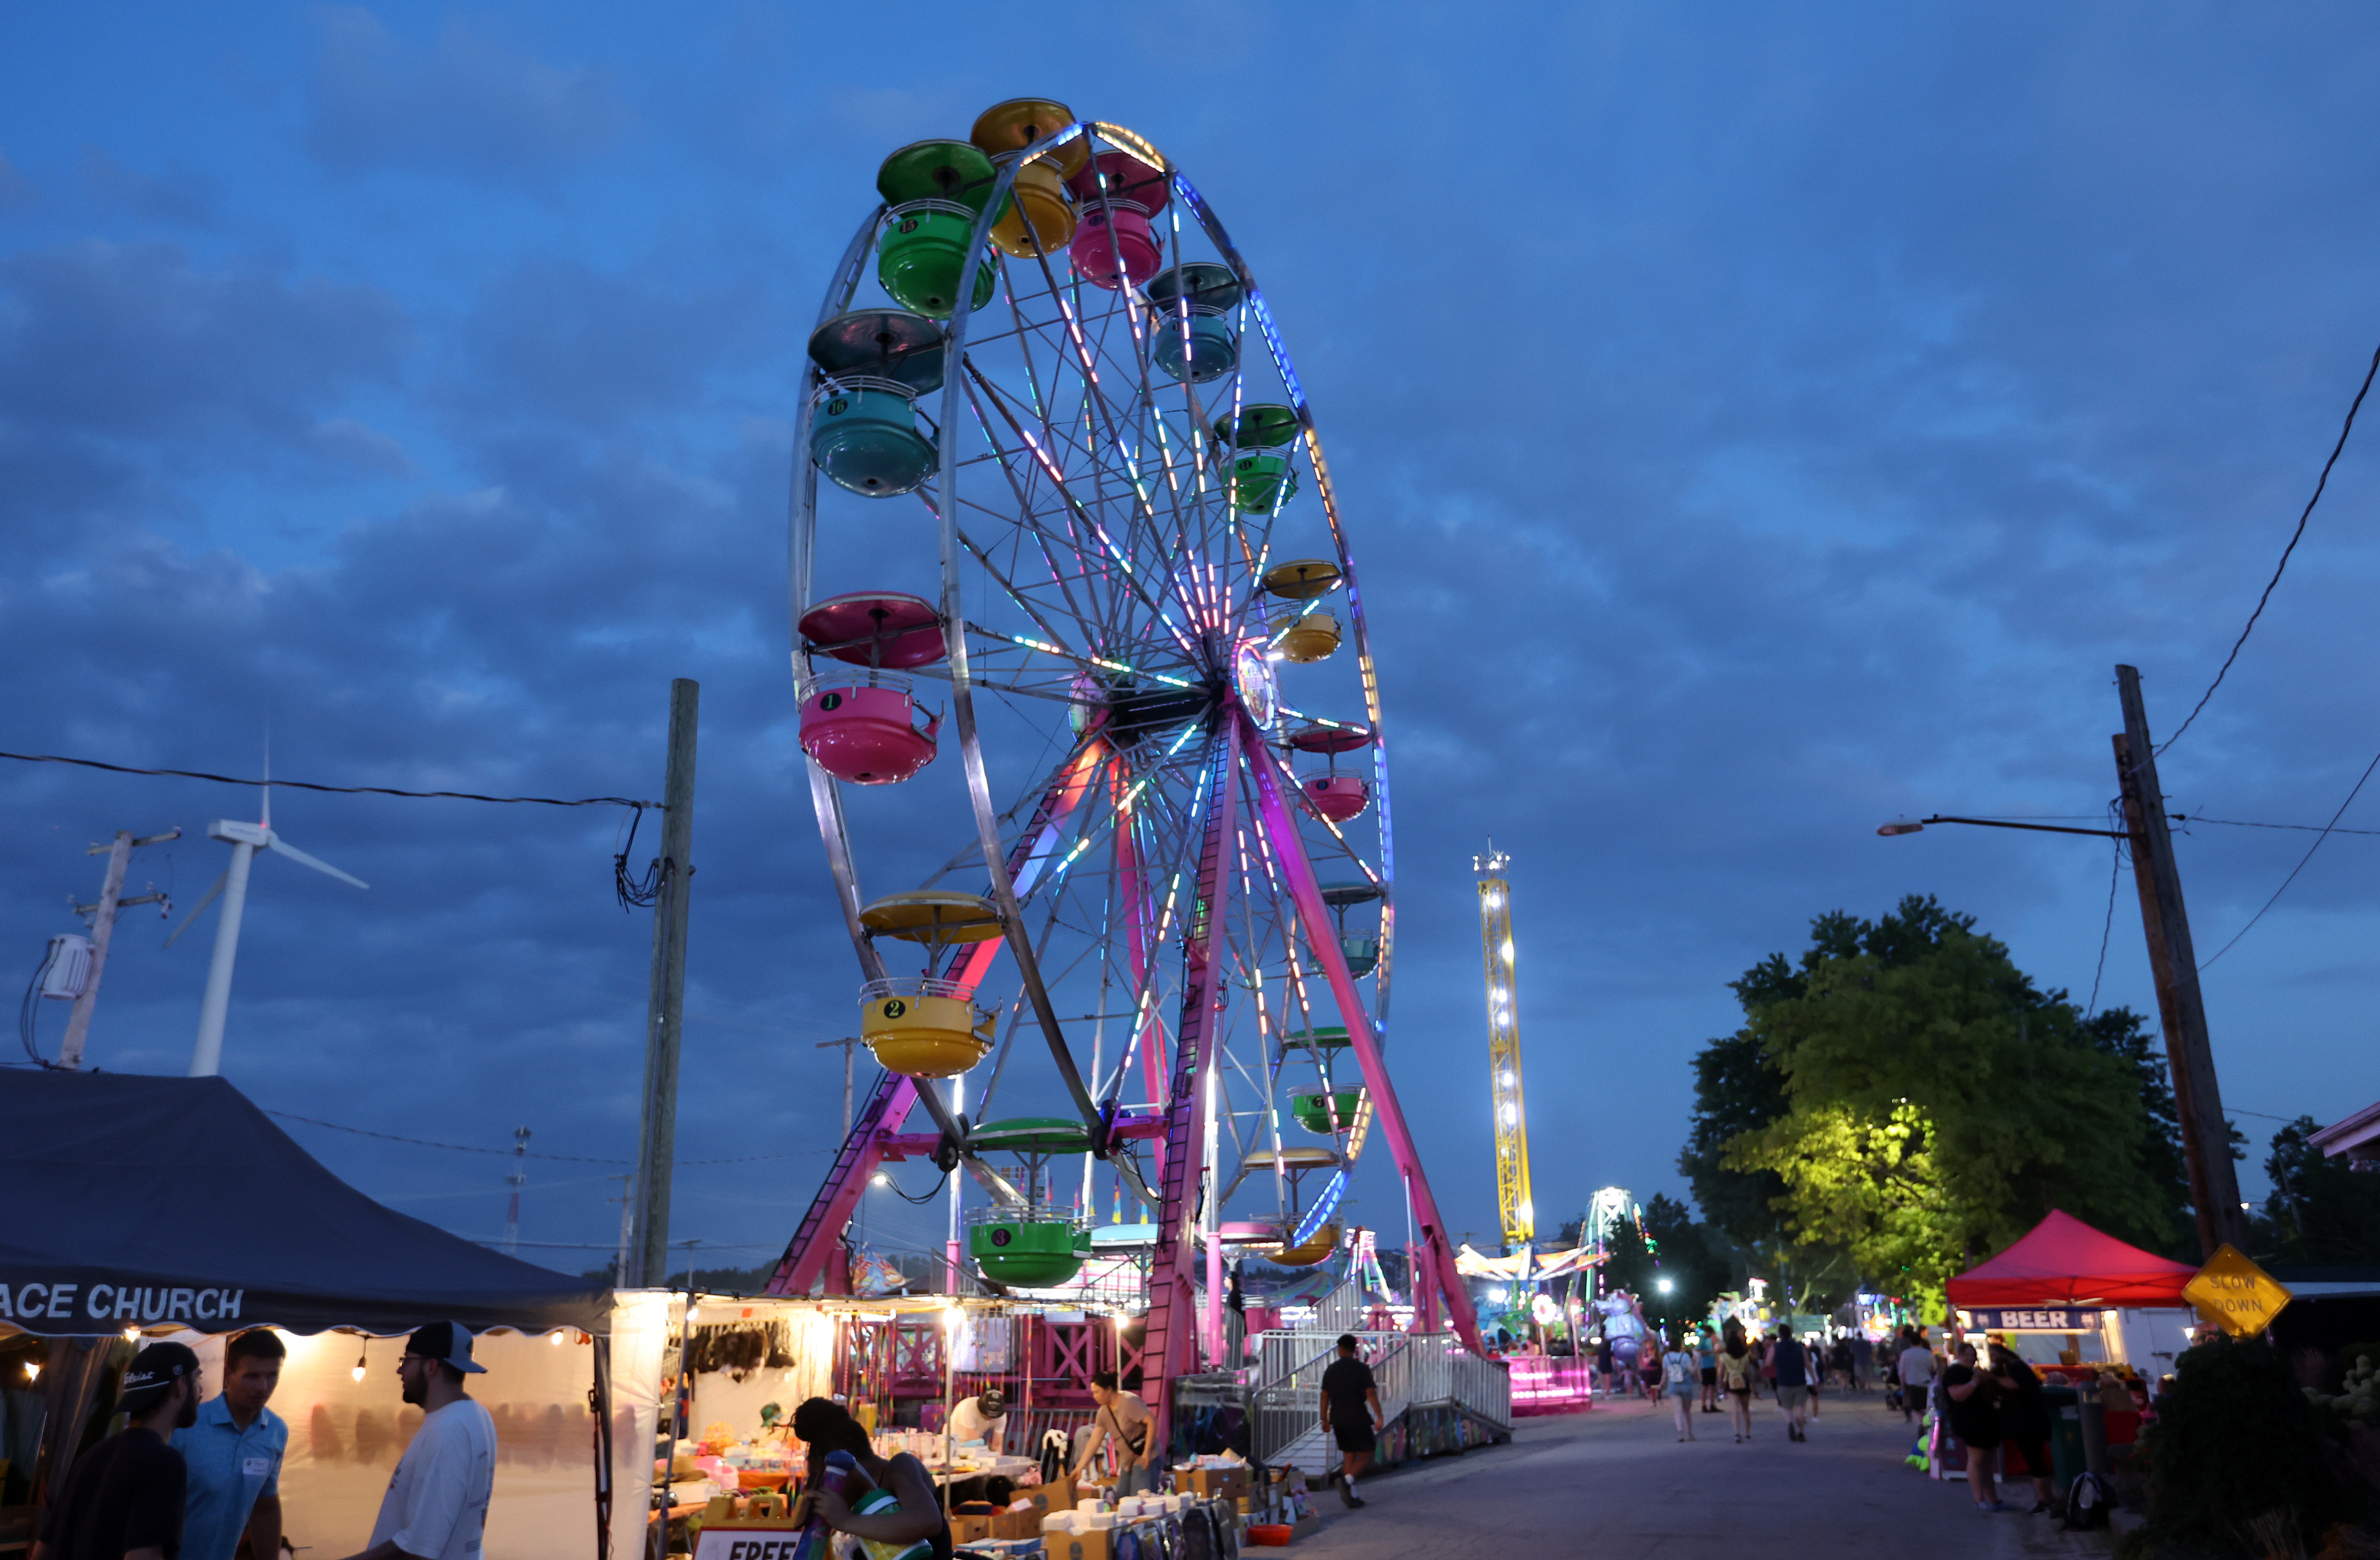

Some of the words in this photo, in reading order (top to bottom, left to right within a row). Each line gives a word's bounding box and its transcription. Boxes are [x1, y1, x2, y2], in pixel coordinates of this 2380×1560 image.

[901, 220, 915, 233] 15
[831, 400, 845, 415] 16
[827, 694, 834, 709] 1
[889, 1001, 900, 1016] 2
[1316, 1097, 1322, 1106] 7
[996, 1230, 1005, 1245] 3
[2210, 1275, 2255, 1290] SLOW
[87, 1283, 244, 1321] CHURCH
[2214, 1298, 2264, 1313] DOWN
[2000, 1311, 2068, 1328] BEER
